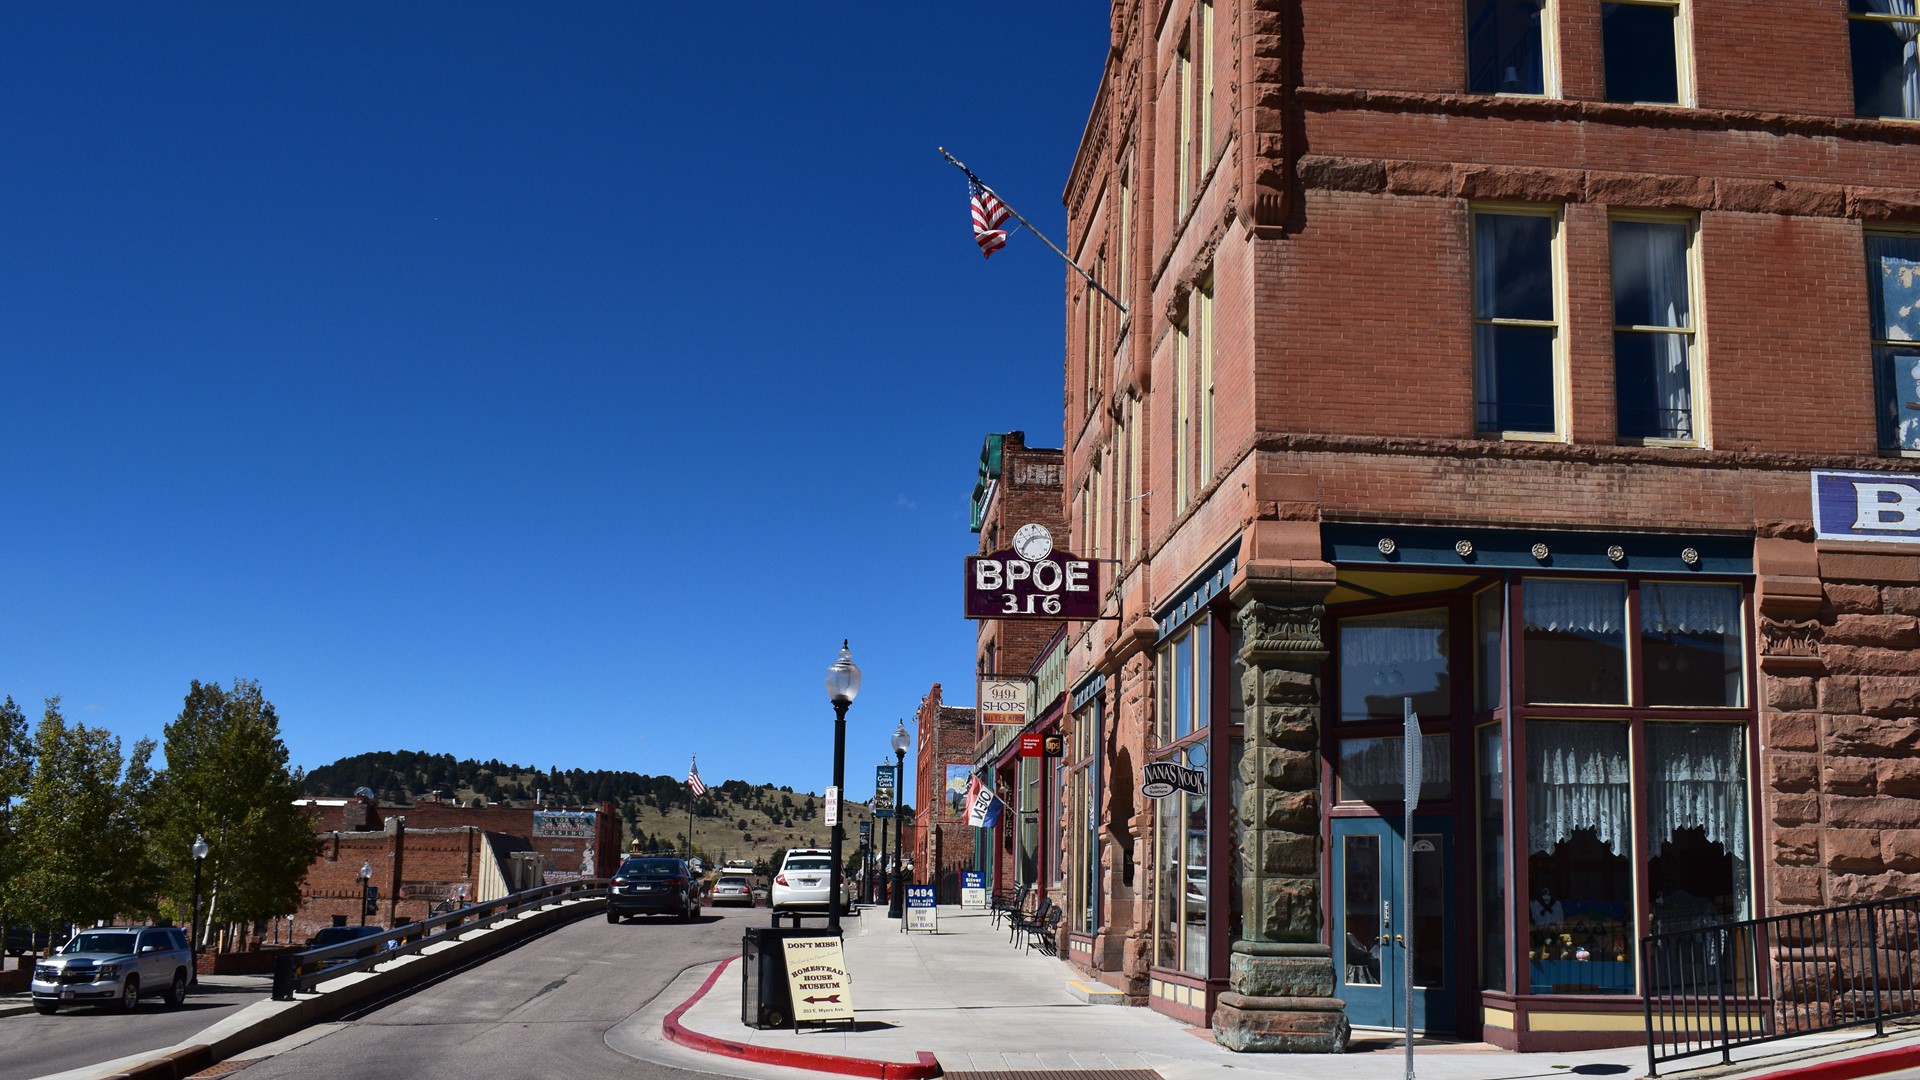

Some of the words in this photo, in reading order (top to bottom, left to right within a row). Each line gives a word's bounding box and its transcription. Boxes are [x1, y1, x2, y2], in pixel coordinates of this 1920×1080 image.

[976, 560, 1090, 592] BPOE
[1002, 594, 1062, 614] 316
[992, 689, 1017, 699] 9494
[982, 702, 1025, 712] SHOPS
[1146, 764, 1176, 784] NANA'S
[1177, 766, 1206, 794] NOOK
[908, 888, 933, 897] 9494
[791, 965, 844, 978] HOMESTEAD
